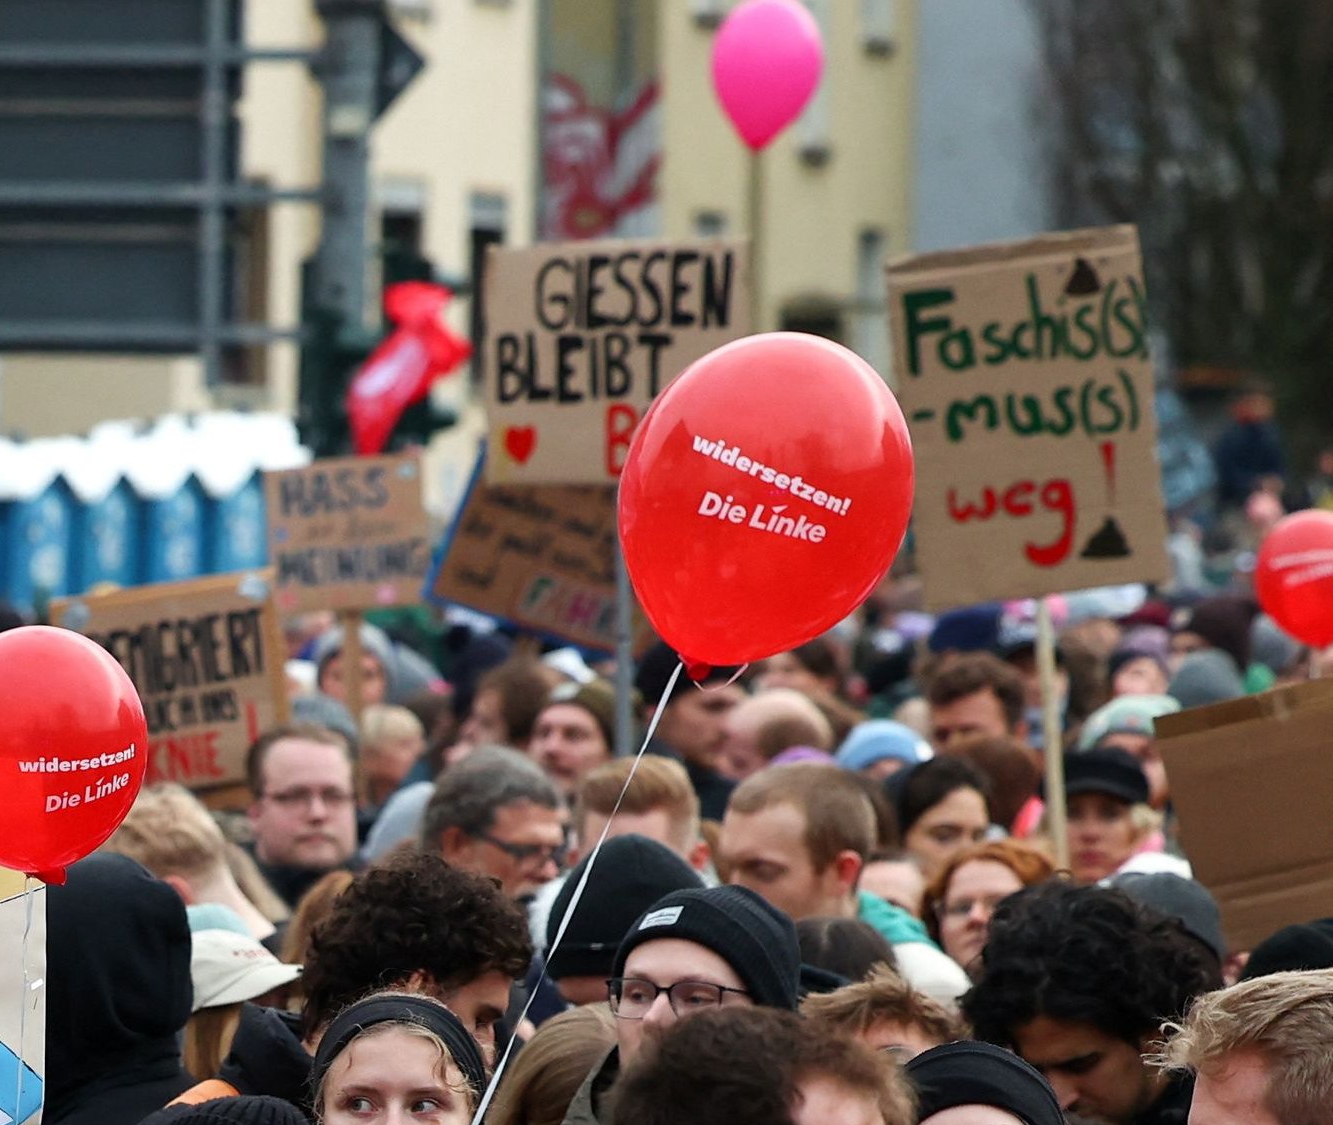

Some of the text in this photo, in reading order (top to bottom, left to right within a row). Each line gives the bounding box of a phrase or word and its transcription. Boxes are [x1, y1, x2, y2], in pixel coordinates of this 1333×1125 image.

[536, 250, 734, 331] GIESSEN
[496, 331, 674, 405] BLEIBT
[280, 467, 389, 518] HASS
[692, 435, 852, 516] widersetzen!
[698, 491, 747, 524] Die
[18, 743, 135, 772] widersetzen!
[45, 791, 81, 813] Die
